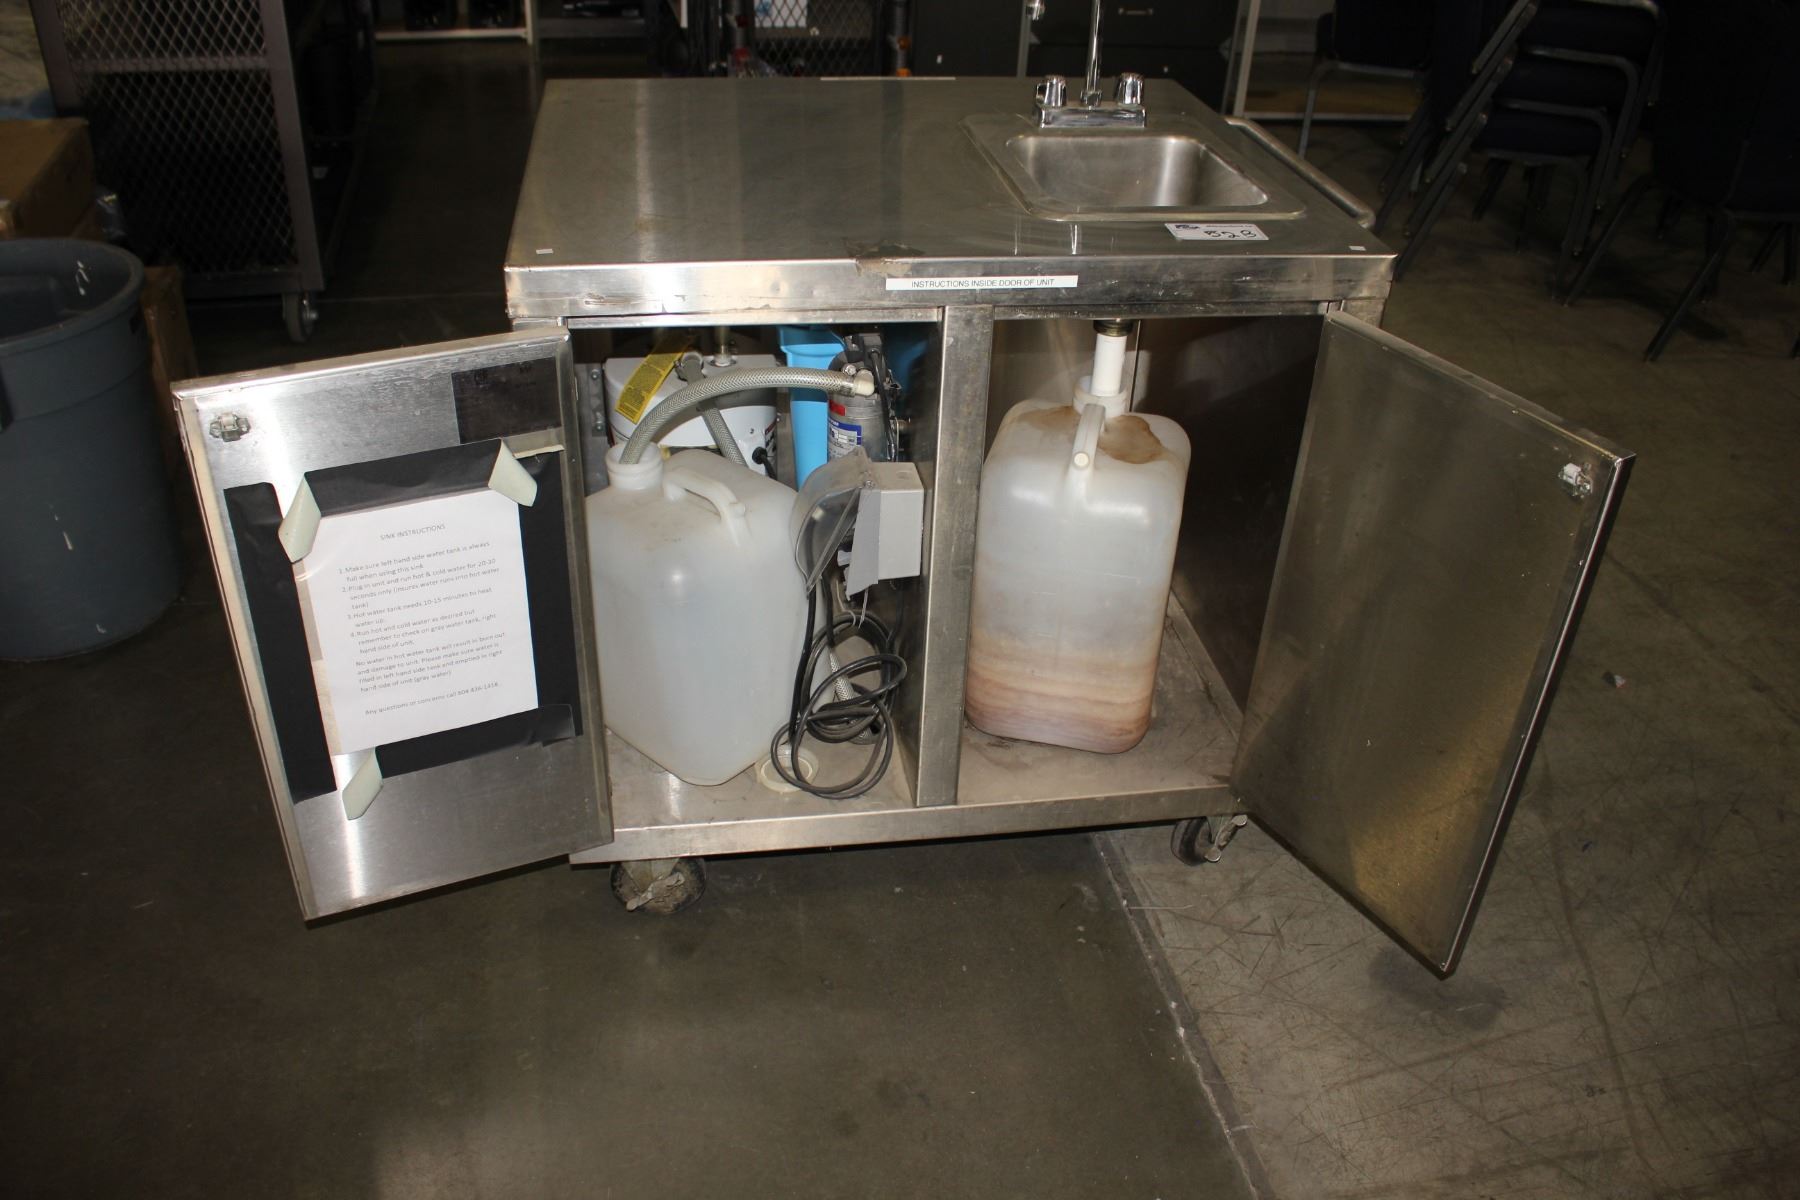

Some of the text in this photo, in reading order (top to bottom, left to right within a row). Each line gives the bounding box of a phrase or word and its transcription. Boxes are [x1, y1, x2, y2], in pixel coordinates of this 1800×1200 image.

[911, 280, 970, 288] INSTRUCTIONS
[971, 279, 998, 287] INSIDE
[999, 279, 1022, 287] DOOR
[1037, 278, 1055, 286] UNIT
[380, 524, 445, 540] SINK INSTRUCTIONS
[468, 541, 490, 550] always
